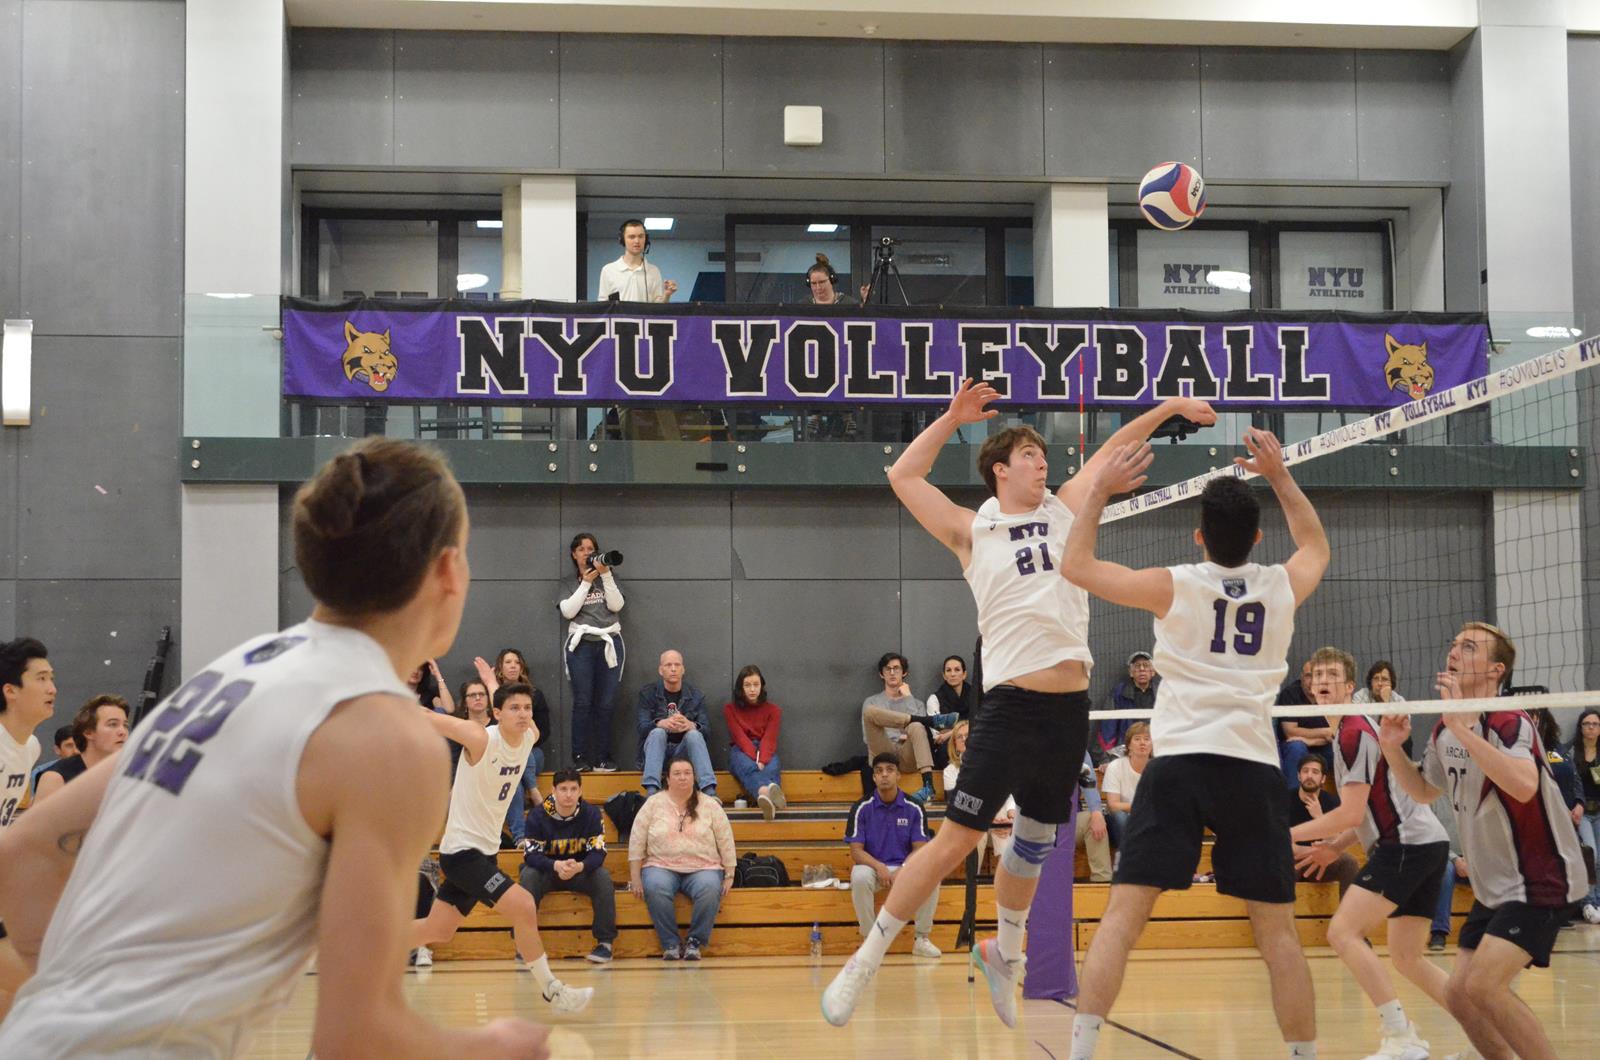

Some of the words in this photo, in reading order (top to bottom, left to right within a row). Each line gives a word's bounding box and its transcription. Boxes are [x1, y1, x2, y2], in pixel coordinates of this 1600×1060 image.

[1308, 267, 1365, 288] NYU
[1163, 285, 1221, 295] ATHLETICS
[1309, 288, 1365, 299] ATHLETICS
[456, 317, 678, 396] NYU
[711, 319, 1330, 401] VOLLEYBALL
[1374, 412, 1392, 432] NYU
[1401, 390, 1456, 422] VOLLEYBALL
[1466, 378, 1488, 401] NYU
[1008, 521, 1049, 542] NYU
[1015, 542, 1054, 576] 21
[1210, 598, 1266, 656] 19
[123, 669, 256, 796] 22
[499, 764, 521, 776] NYU
[498, 781, 512, 801] 8
[954, 789, 984, 812] NYU
